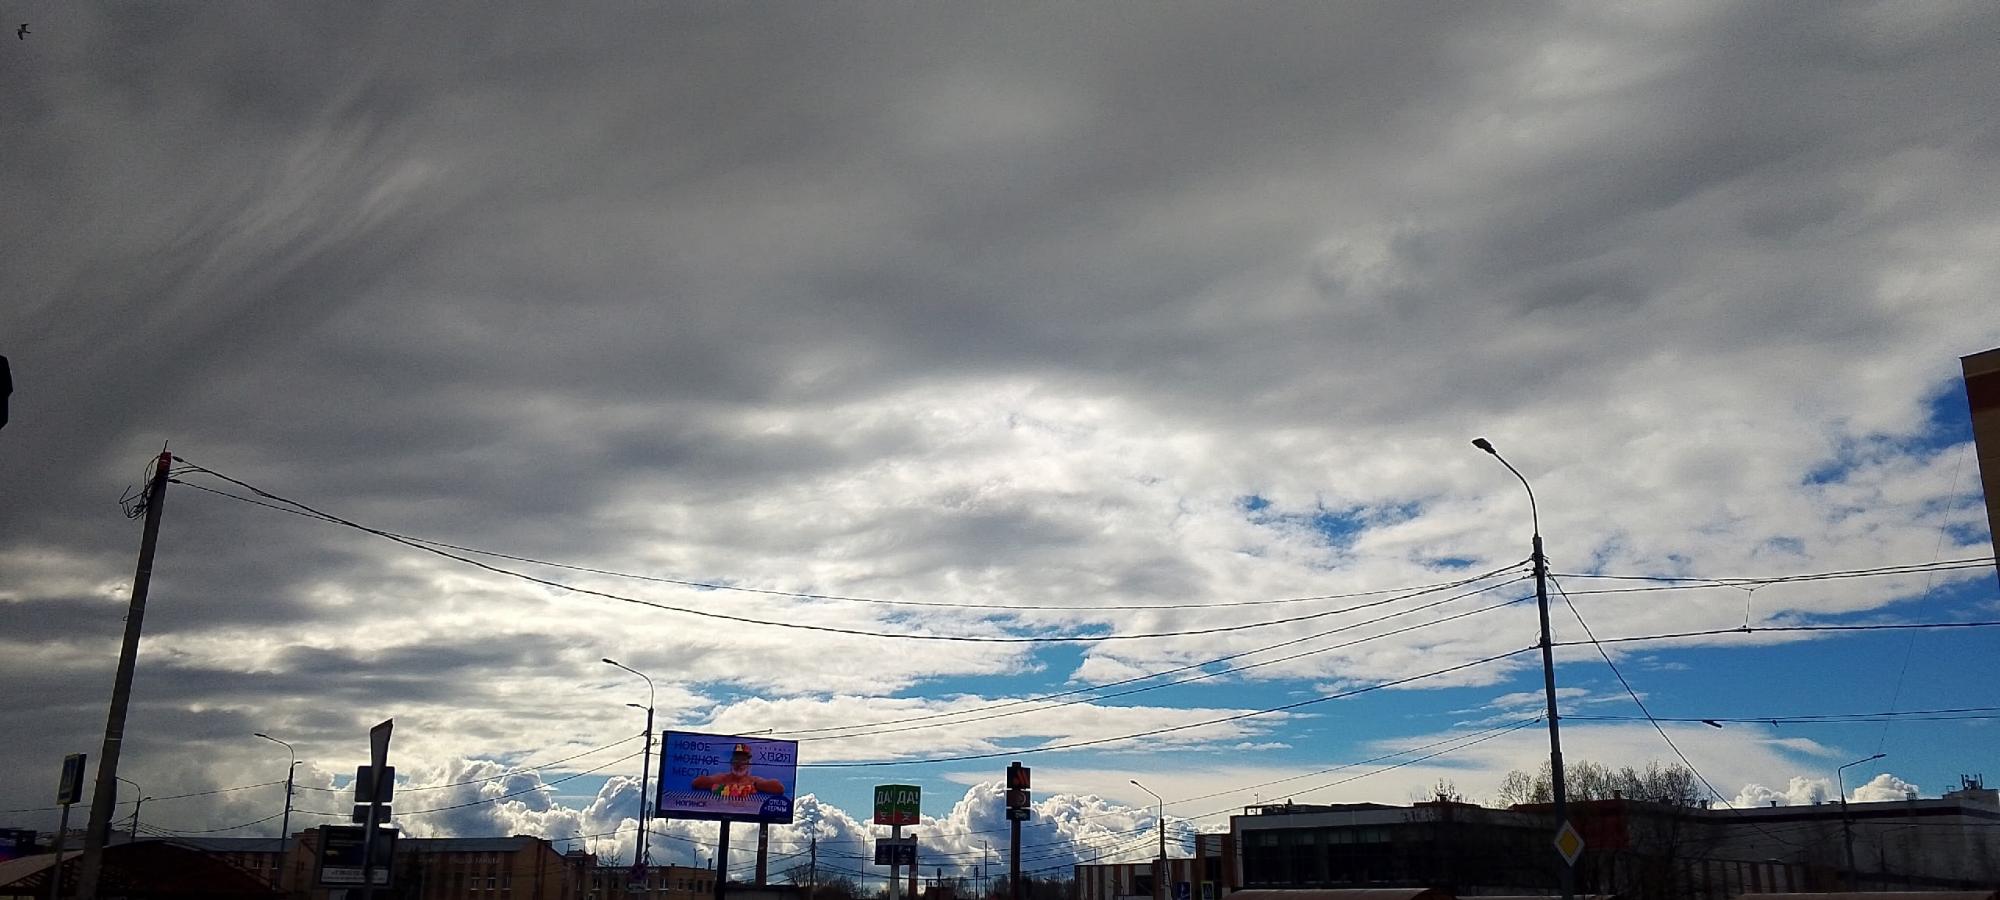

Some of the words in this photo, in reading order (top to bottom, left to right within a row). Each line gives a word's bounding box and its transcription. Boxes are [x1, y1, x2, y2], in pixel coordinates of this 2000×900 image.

[674, 739, 712, 752] НОВОЕ
[672, 753, 720, 766] МОДНОЕ
[672, 767, 709, 777] МЕСТО
[876, 791, 893, 805] ДА!
[897, 790, 919, 805] ДА!
